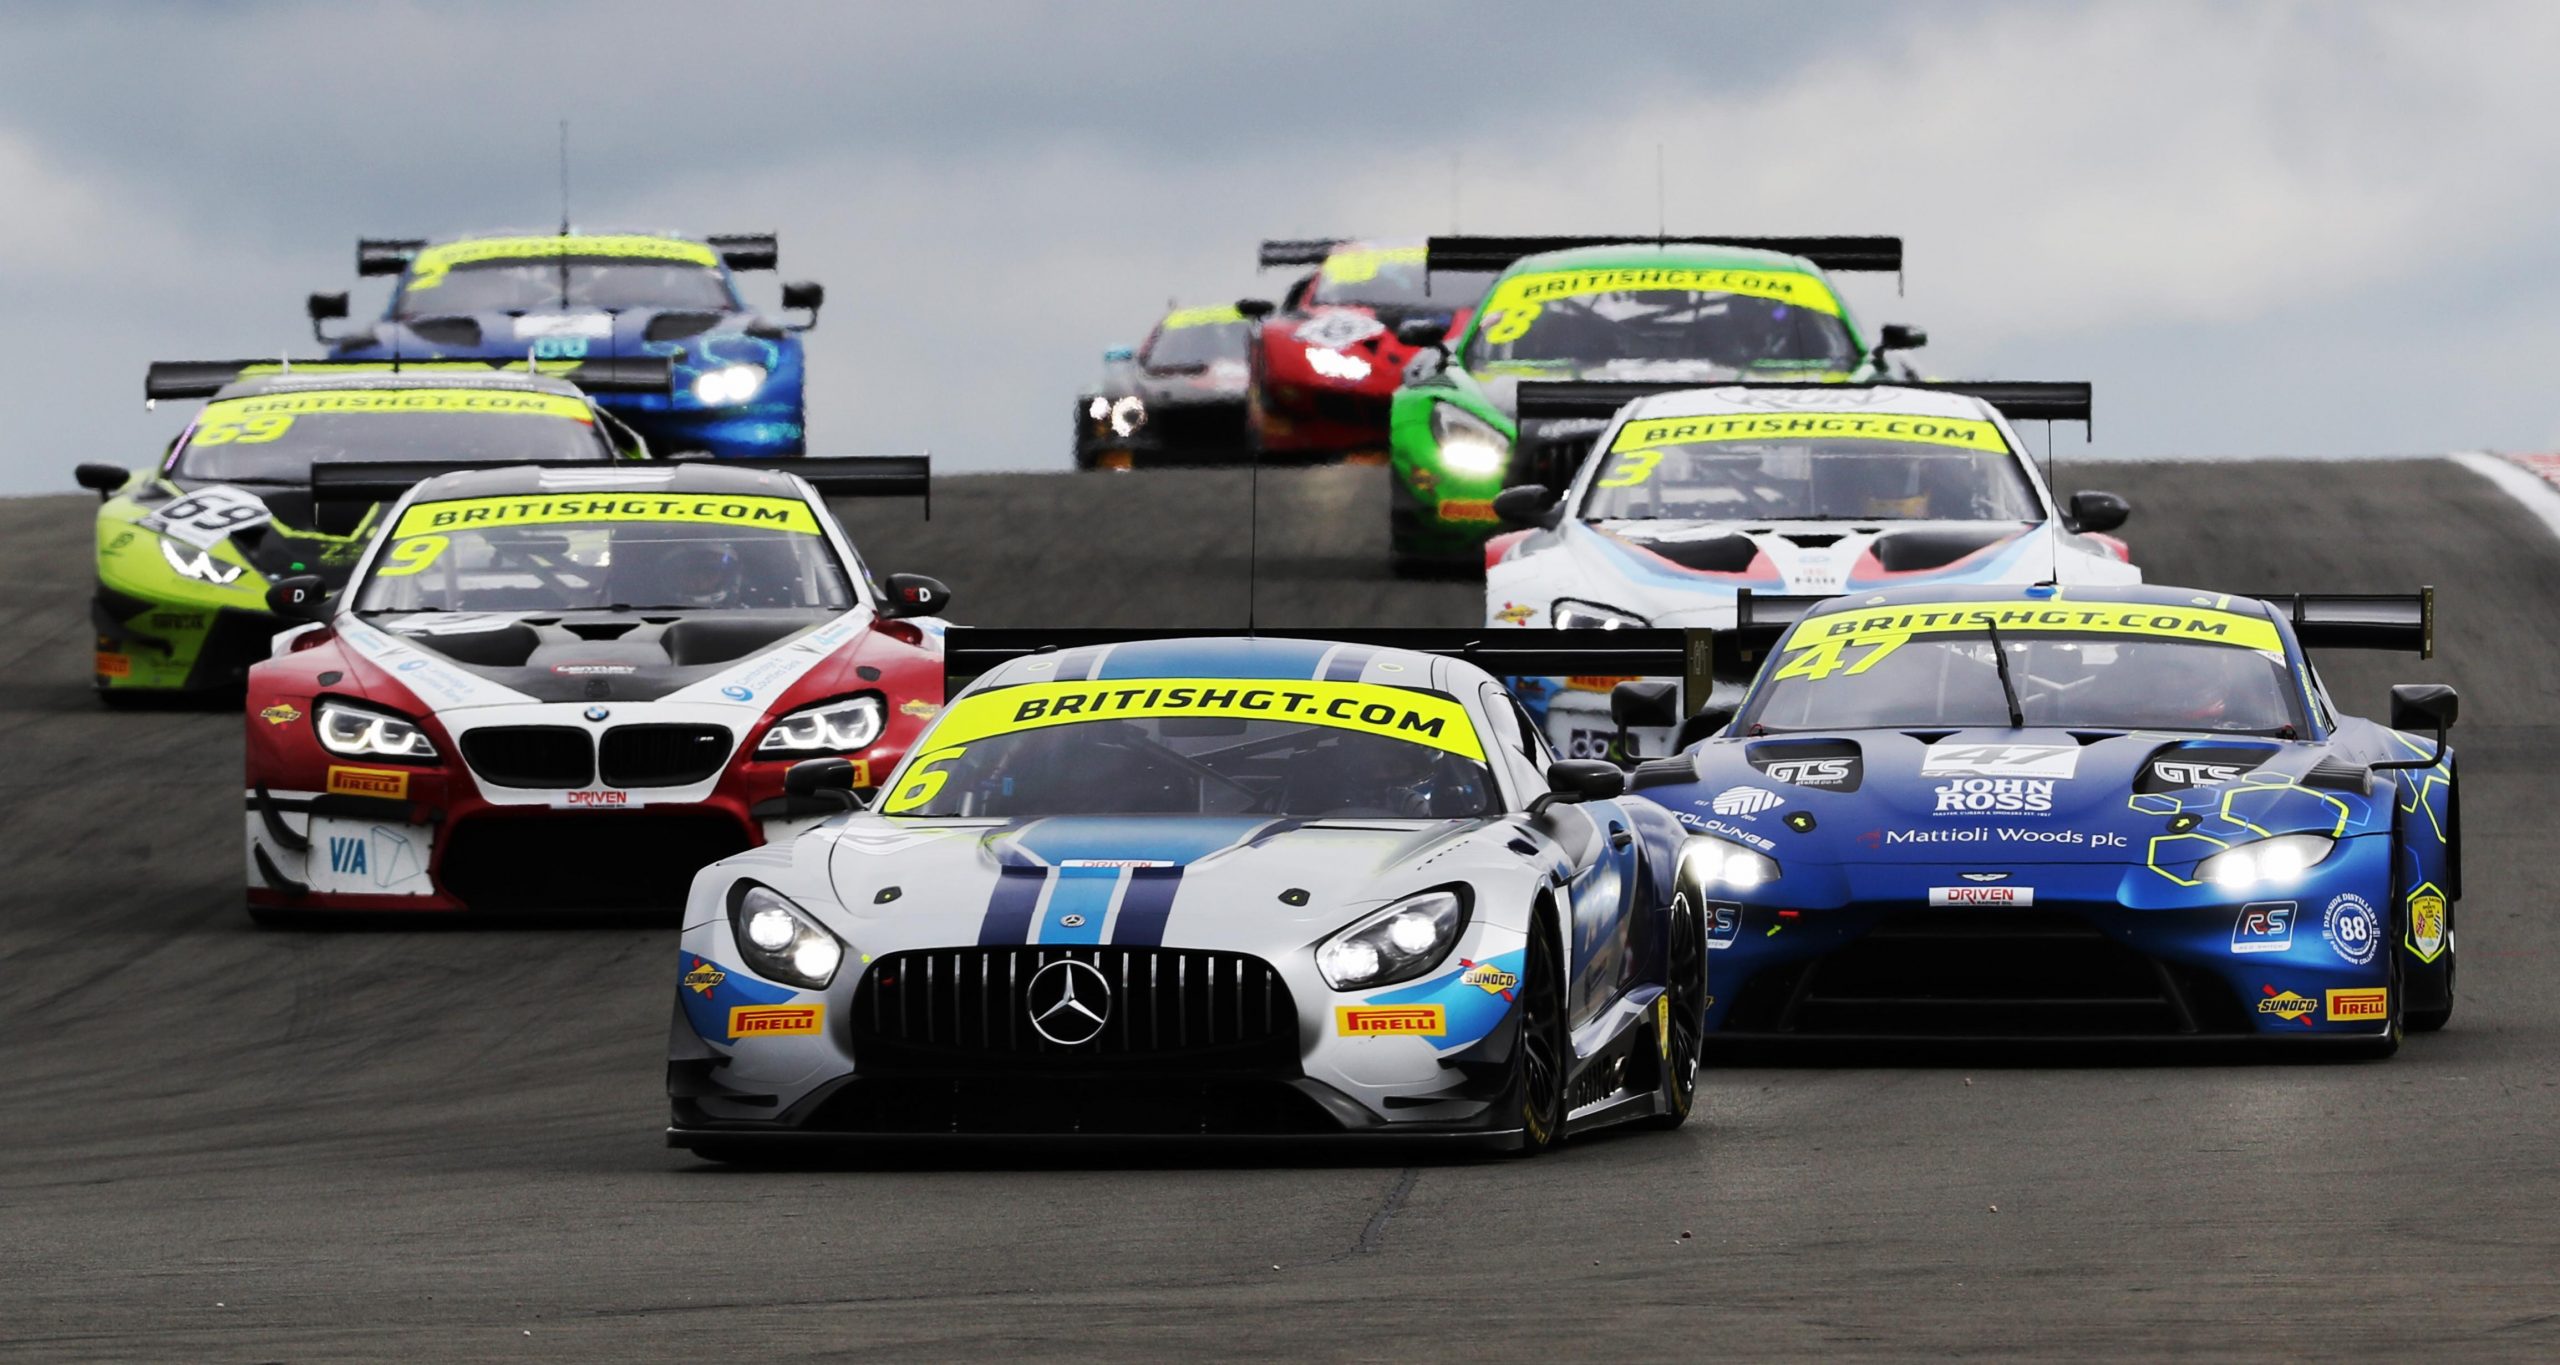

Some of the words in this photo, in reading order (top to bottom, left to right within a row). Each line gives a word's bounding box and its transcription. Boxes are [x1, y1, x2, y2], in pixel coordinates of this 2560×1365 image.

[1522, 270, 1793, 298] BRITISHGT.COM
[1486, 303, 1543, 344] 8
[243, 396, 547, 414] BRITISHGT.COM
[191, 413, 295, 448] 69
[1644, 418, 1977, 442] BRITISHGT.COM
[1598, 451, 1664, 488] 3
[160, 494, 264, 530] 69
[432, 499, 790, 527] BRITISHGT.COM
[376, 535, 450, 577] 9
[1826, 610, 2228, 638] BRITISHGT.COM
[1773, 633, 1912, 681] 47
[1012, 688, 1447, 738] BRITISHGT.COM
[1930, 746, 2079, 765] 47
[333, 770, 402, 793] PIRELLI
[883, 746, 968, 813] 6
[1766, 760, 1853, 782] GTS
[2154, 762, 2241, 785] GTS
[1934, 778, 2056, 795] JOHN
[567, 791, 627, 807] DRIVEN
[1934, 793, 2053, 812] ROSS
[1886, 827, 1988, 844] Mattioli
[1996, 827, 2084, 844] Woods
[2091, 832, 2128, 848] plc
[1947, 888, 2014, 905] DRIVEN
[2323, 894, 2342, 928] DEESIDE
[2341, 892, 2378, 926] DISTILLERY
[2243, 909, 2290, 936] RS
[2339, 916, 2367, 941] 88
[686, 972, 723, 984] SUNOCO
[1465, 971, 1515, 987] SUNOCO
[2260, 1000, 2316, 1012] SUNOCO
[2333, 994, 2384, 1015] PIRELLI
[736, 1009, 815, 1032] PIRELLI
[1347, 1009, 1436, 1031] PIRELLI
